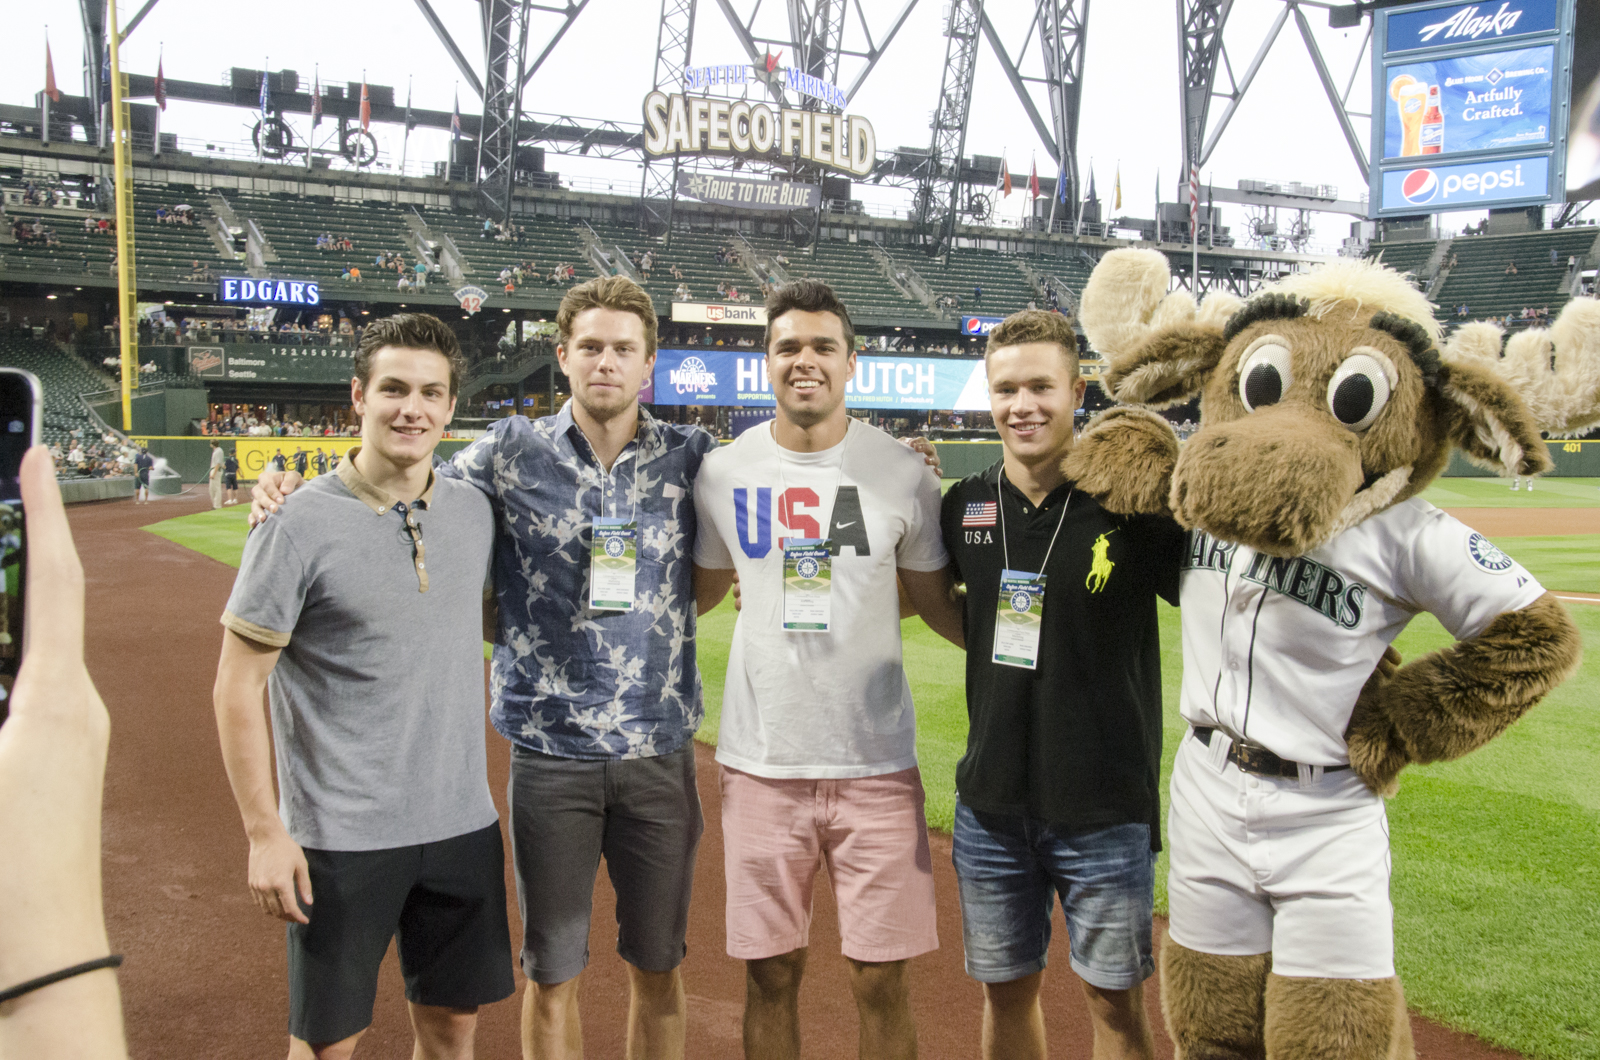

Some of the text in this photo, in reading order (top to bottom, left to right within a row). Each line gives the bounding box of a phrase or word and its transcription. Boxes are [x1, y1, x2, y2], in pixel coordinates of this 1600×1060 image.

[1418, 2, 1523, 42] Alaska
[684, 65, 847, 109] SEATTLE MARINERS
[1464, 86, 1523, 104] Artfully
[1462, 102, 1523, 121] Crafted.
[643, 91, 877, 177] SAFECO FIELD
[703, 175, 811, 207] TRUE TO THE BLUE
[1443, 164, 1524, 198] pepsi
[223, 280, 319, 304] EDGAR'S
[462, 297, 481, 311] 42
[228, 357, 266, 366] Baltimore
[228, 370, 257, 378] Seattle
[846, 361, 935, 395] UTCH
[737, 393, 771, 401] SUPPORTING
[1563, 443, 1581, 453] 401
[733, 486, 871, 559] USA
[965, 531, 993, 544] USA
[1182, 528, 1367, 630] ARINERS
